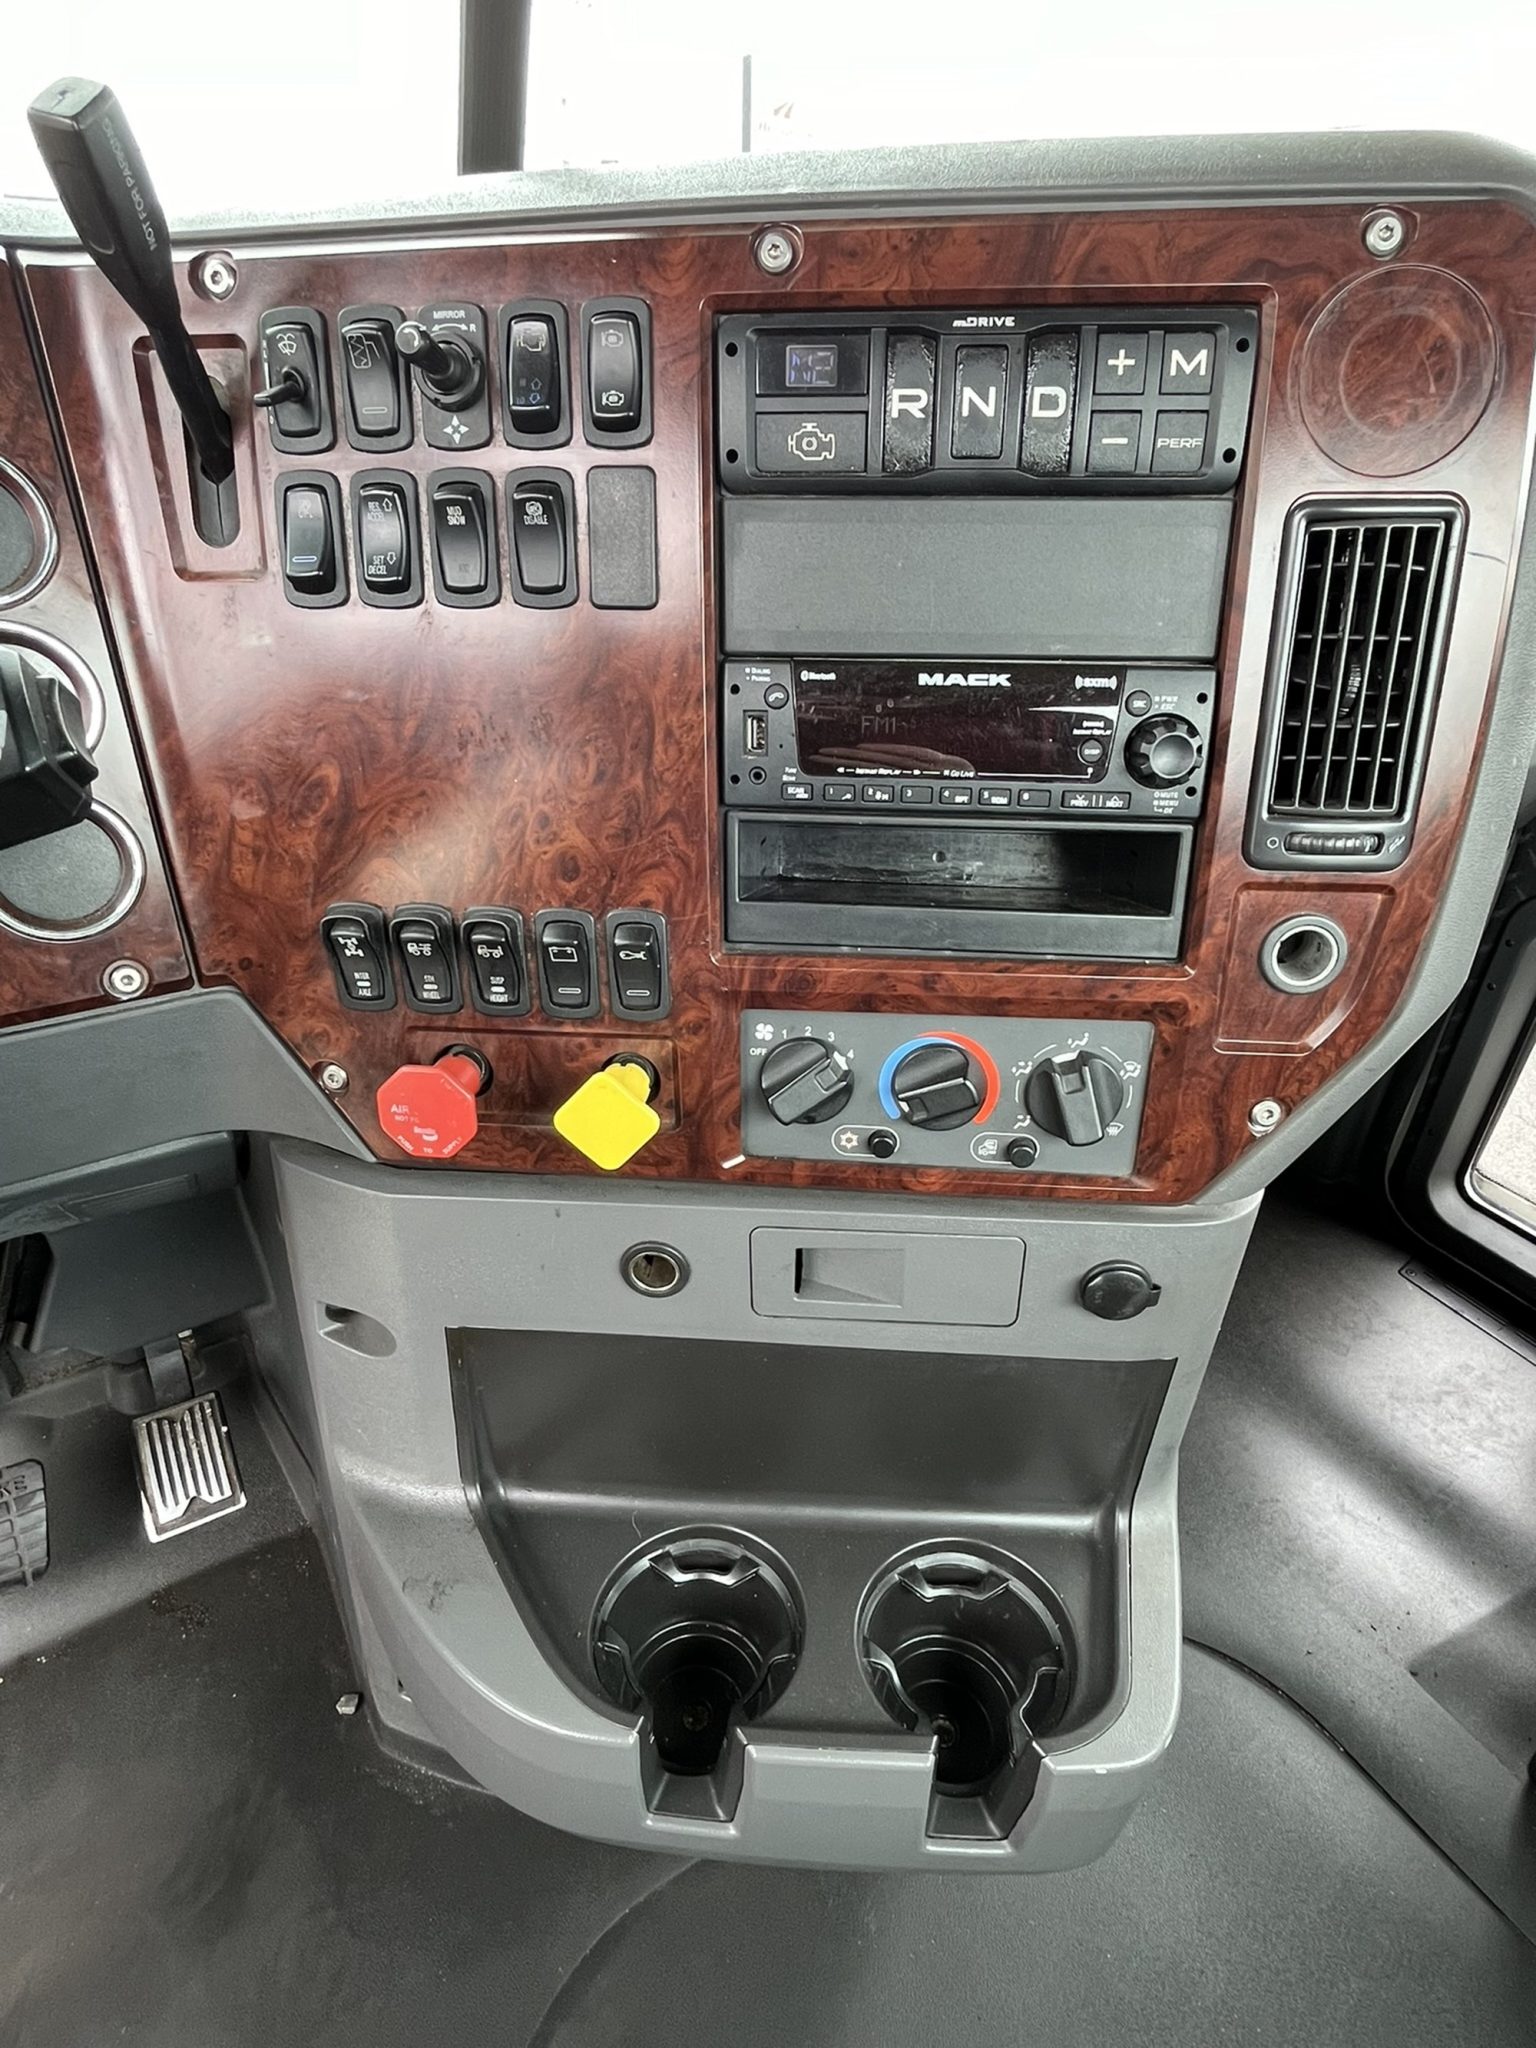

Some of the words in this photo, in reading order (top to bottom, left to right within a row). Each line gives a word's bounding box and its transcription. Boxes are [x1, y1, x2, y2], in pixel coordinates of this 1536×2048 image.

[102, 118, 136, 188] PARKING
[131, 186, 147, 220] FOR
[142, 221, 157, 251] NOT
[433, 310, 466, 320] MIRROR
[470, 323, 477, 332] R
[1169, 348, 1208, 377] M
[891, 388, 928, 418] R
[962, 386, 996, 417] N
[1032, 386, 1067, 418] D
[1157, 437, 1203, 449] PERF
[447, 515, 466, 525] SNOW
[373, 555, 385, 565] SET
[368, 565, 387, 575] DECEL
[918, 672, 1011, 687] MACK
[906, 789, 912, 797] 3
[1160, 791, 1179, 799] MUTE
[490, 976, 505, 985] SUSP
[358, 988, 372, 997] AXLE
[423, 991, 441, 999] WHEEL
[782, 1029, 787, 1039] 1
[804, 1026, 812, 1037] 2
[828, 1031, 835, 1042] 3
[749, 1048, 768, 1056] OFF
[846, 1049, 854, 1059] 4
[390, 1104, 409, 1115] AIR
